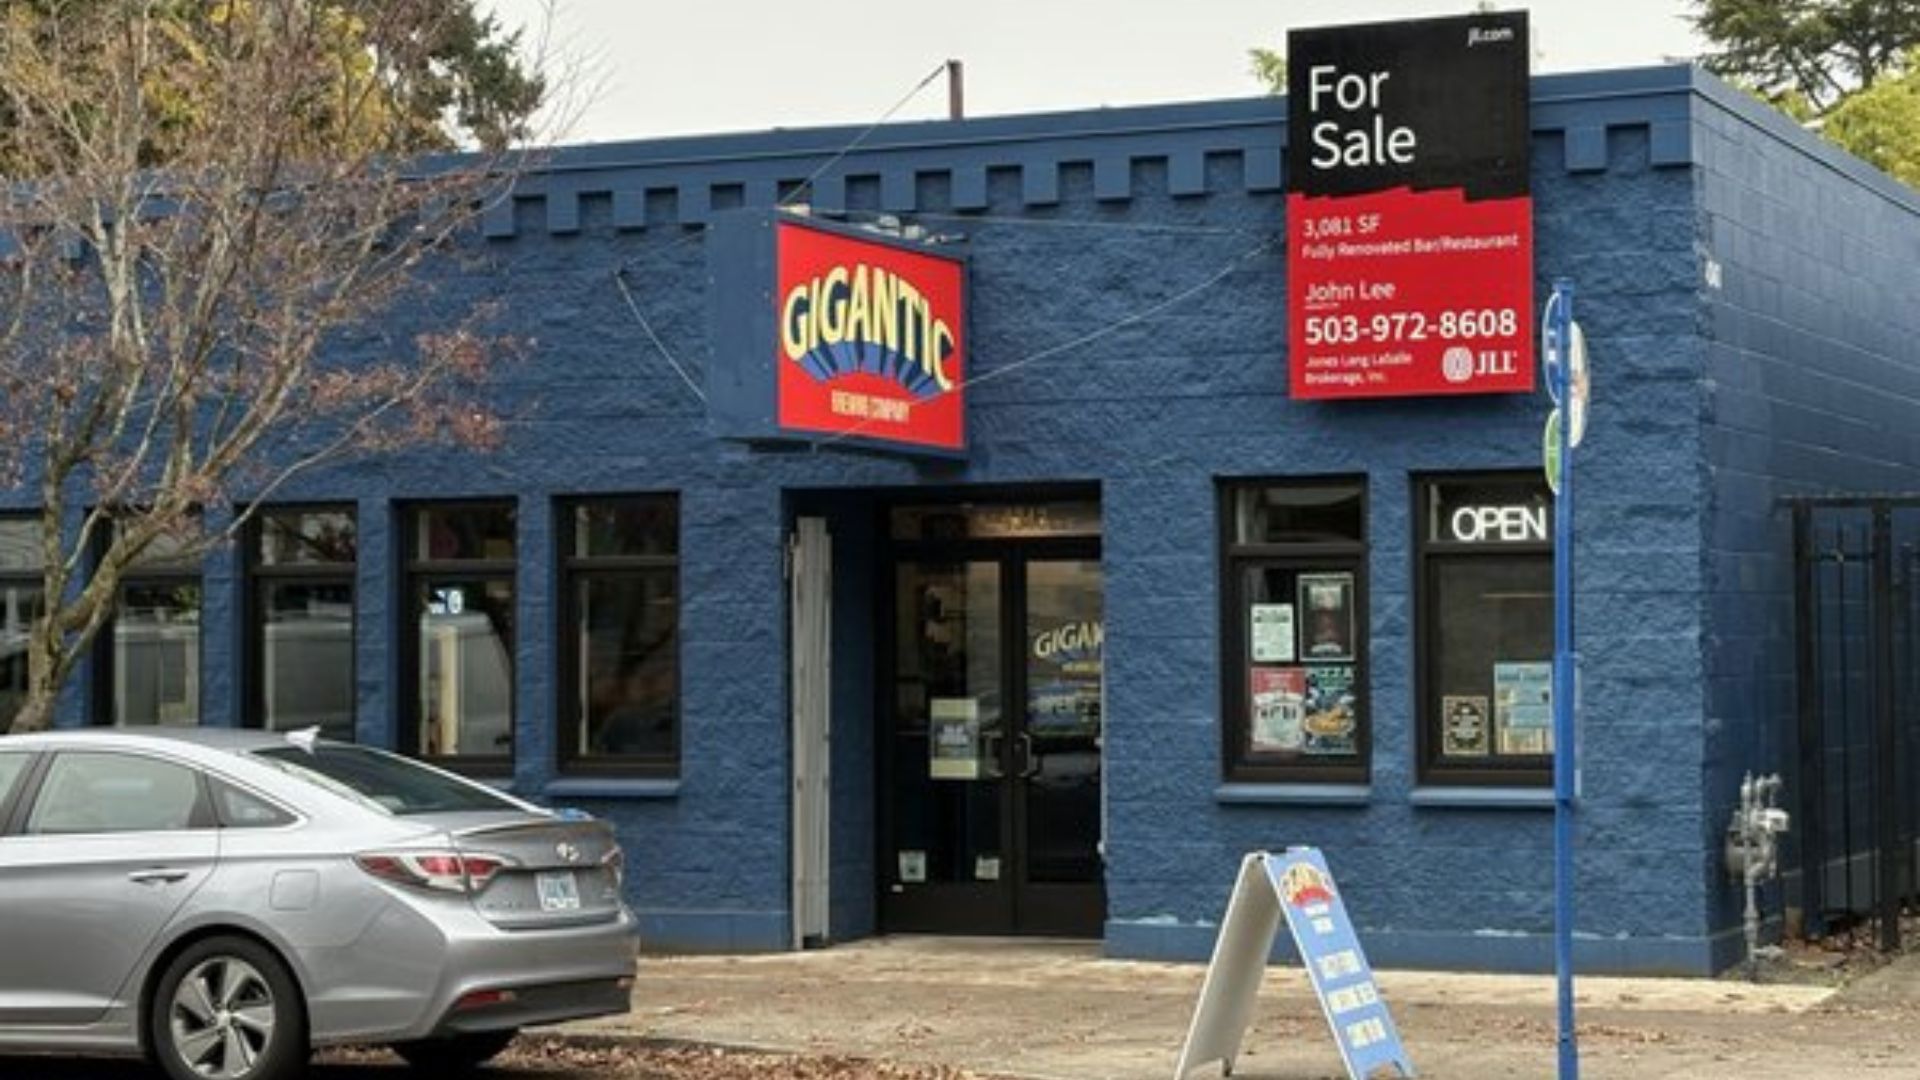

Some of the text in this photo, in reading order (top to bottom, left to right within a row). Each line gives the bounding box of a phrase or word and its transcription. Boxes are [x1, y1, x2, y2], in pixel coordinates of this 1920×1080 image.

[1310, 65, 1390, 112] For
[1311, 114, 1416, 169] Sale
[1303, 214, 1381, 239] 3,081 SF
[1302, 234, 1519, 261] Fully Renovated Bar/Restaurant
[1305, 280, 1396, 302] John Lee
[783, 263, 955, 392] GIGANTIC
[1304, 308, 1518, 345] 503-972-8608
[1305, 354, 1338, 369] Jones
[1341, 353, 1369, 369] Lang
[1475, 350, 1518, 374] JLL
[1451, 506, 1547, 541] OPEN
